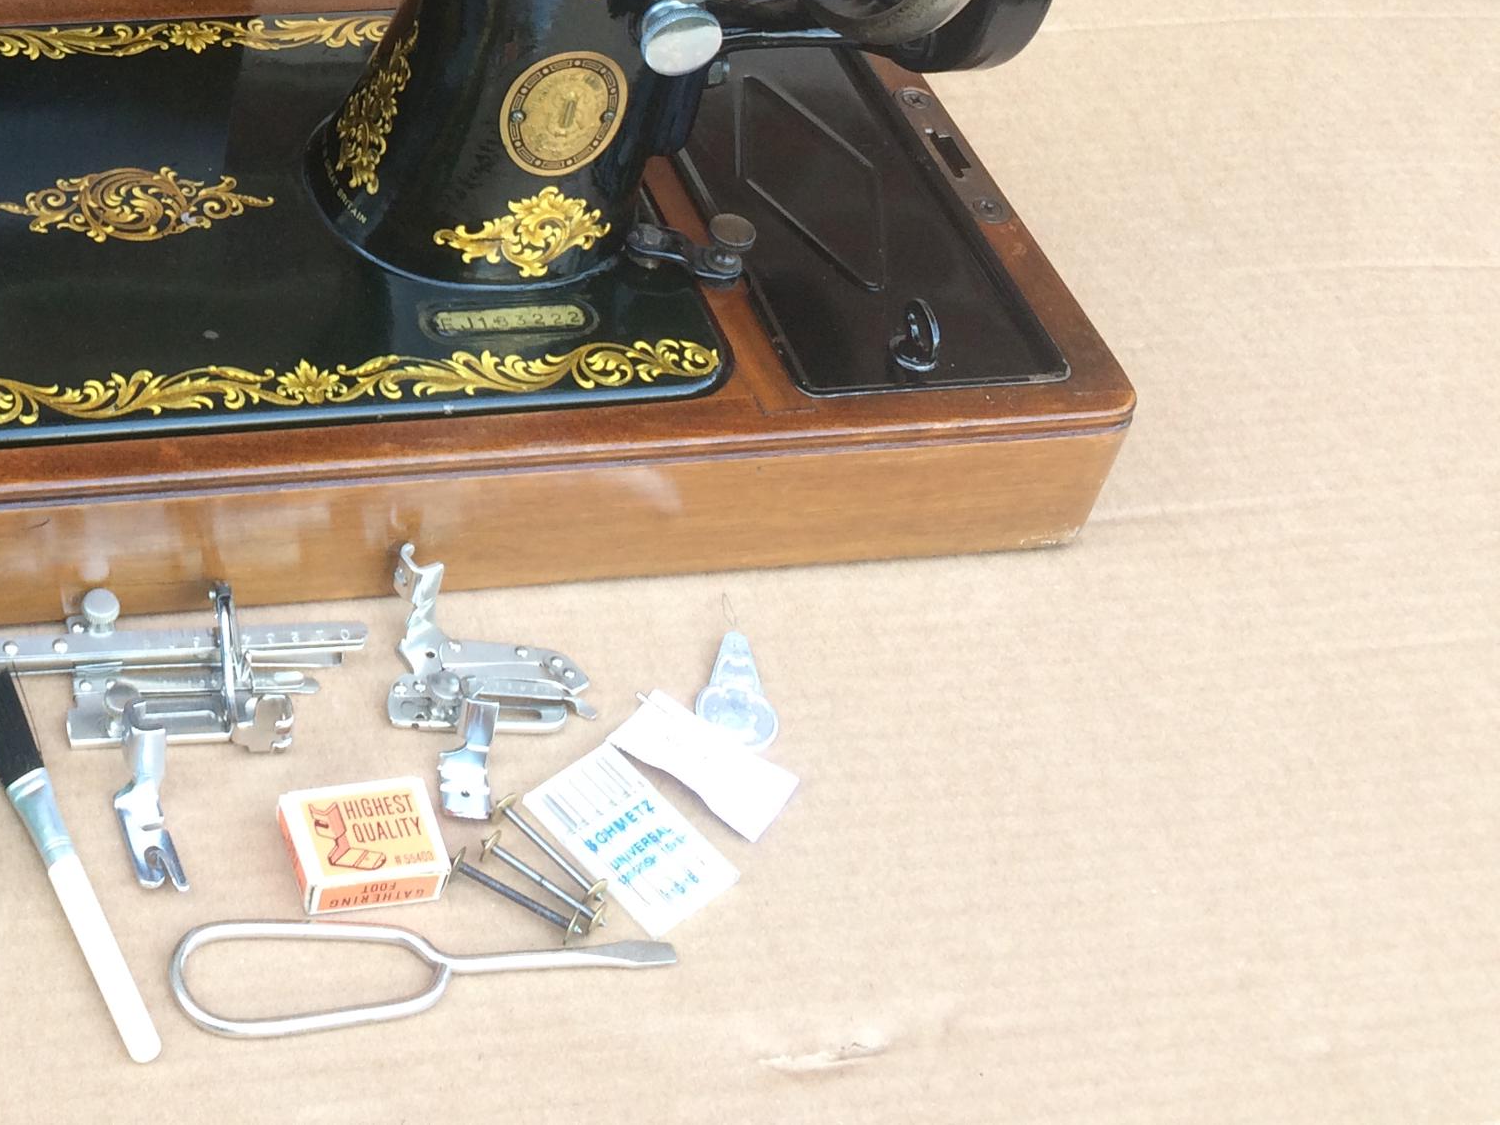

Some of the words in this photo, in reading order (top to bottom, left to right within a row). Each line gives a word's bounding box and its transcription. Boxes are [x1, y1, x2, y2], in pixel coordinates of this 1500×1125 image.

[343, 794, 414, 820] HIGHEST
[352, 817, 422, 843] QUALITY
[329, 888, 425, 908] GATHERING
[361, 881, 397, 894] FOOT
